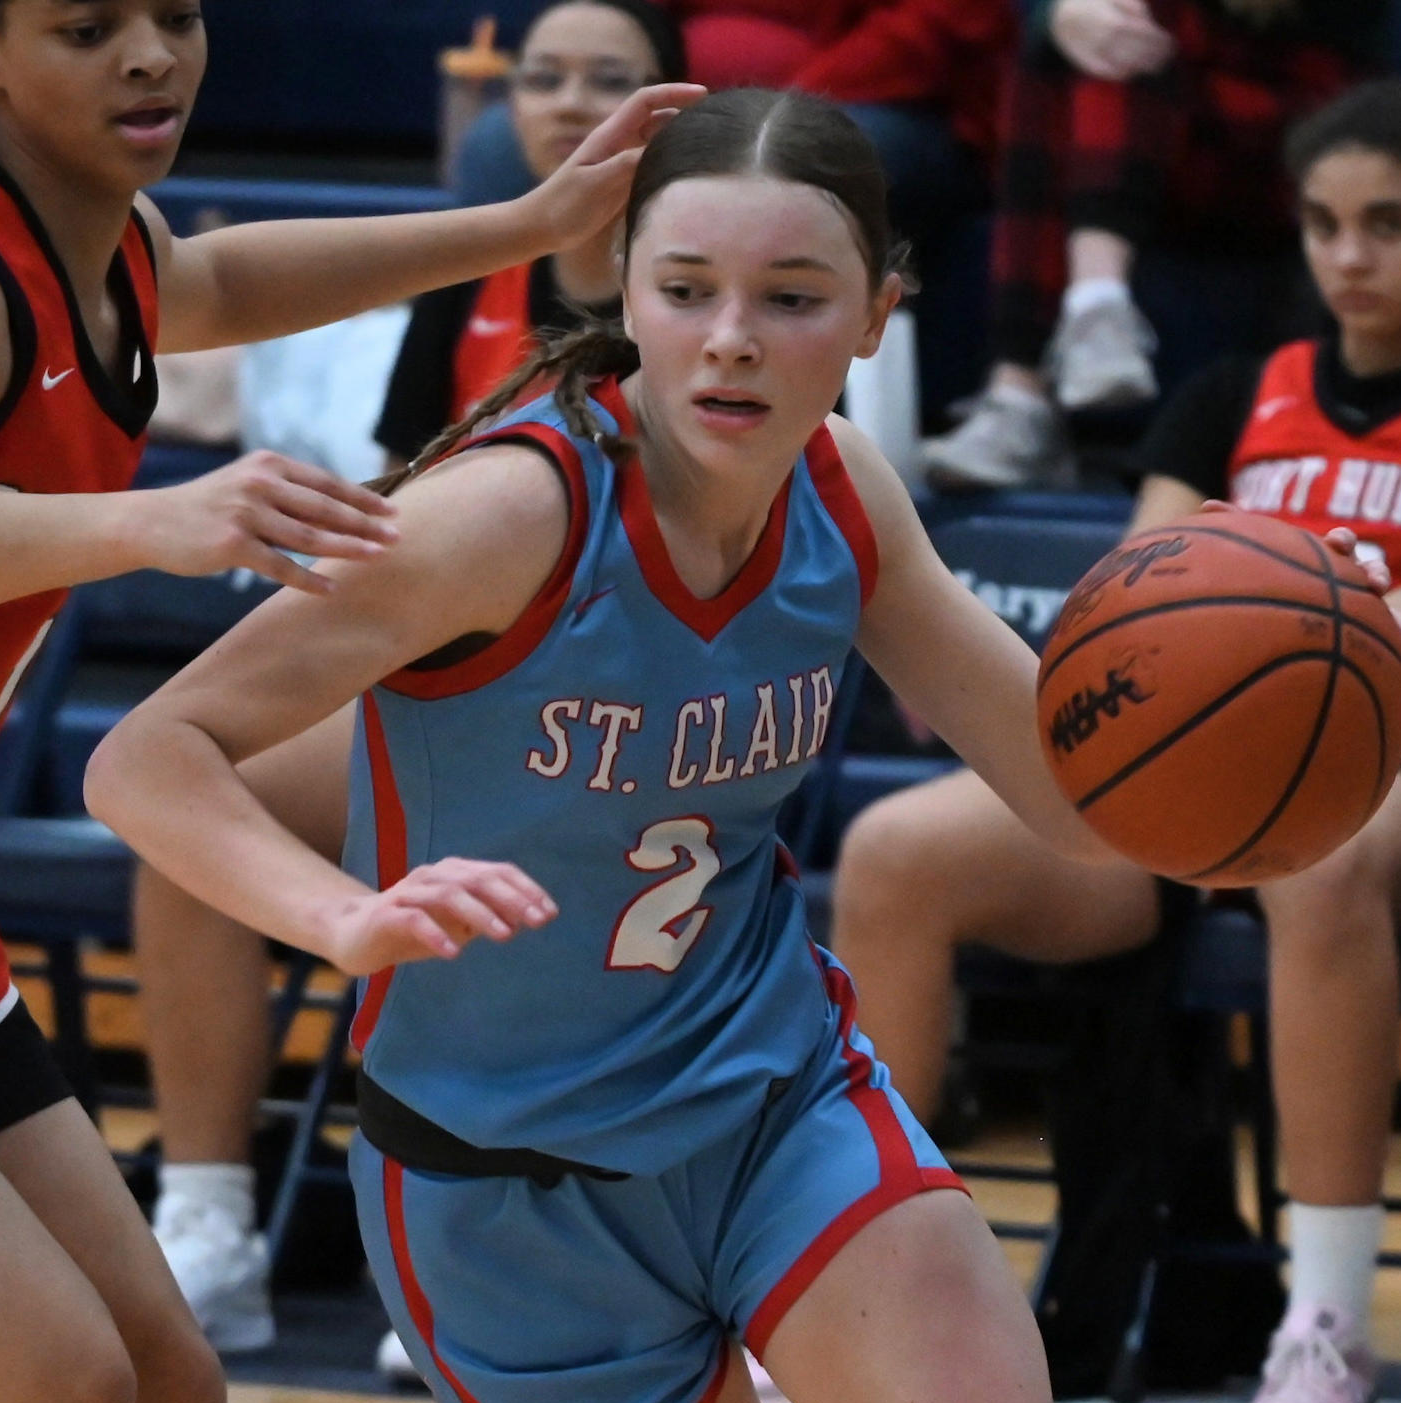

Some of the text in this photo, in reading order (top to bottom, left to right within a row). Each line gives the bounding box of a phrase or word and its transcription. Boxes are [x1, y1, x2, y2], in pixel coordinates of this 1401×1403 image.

[525, 662, 837, 794] ST. CLAIR
[603, 812, 722, 976] 2
